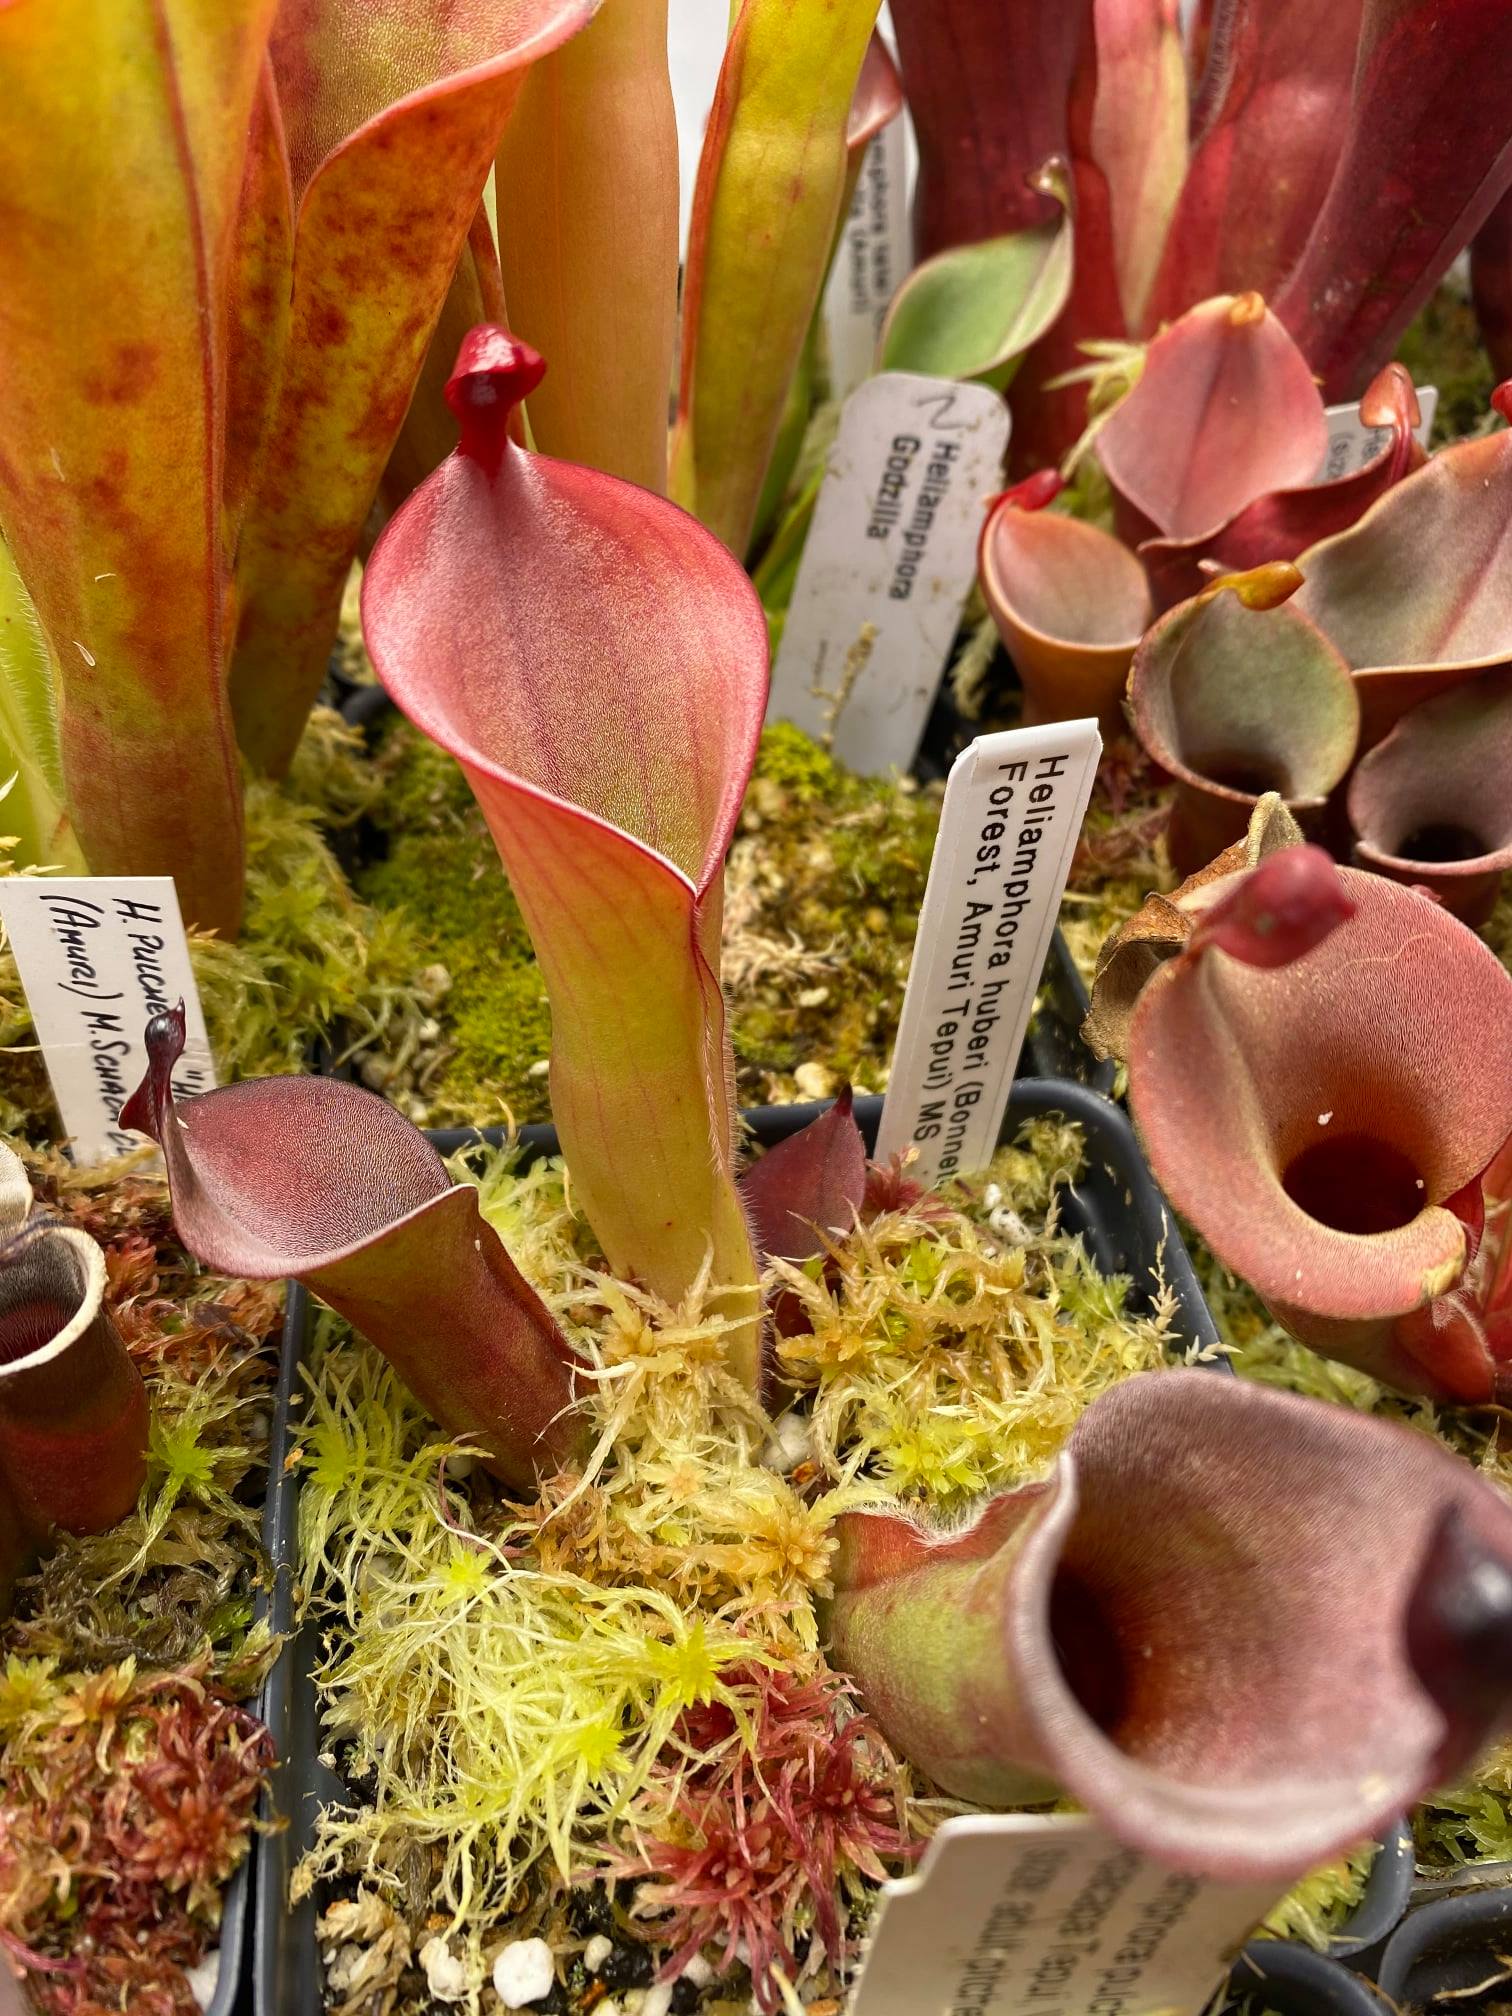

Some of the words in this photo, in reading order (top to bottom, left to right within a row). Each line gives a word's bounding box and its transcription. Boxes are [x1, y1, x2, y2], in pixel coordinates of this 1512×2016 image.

[867, 433, 921, 540] Godzilla
[889, 440, 960, 600] Heliamphora
[967, 760, 1028, 886] Forest,
[987, 754, 1069, 970] Heliamphora
[112, 898, 163, 924] H.
[947, 901, 993, 991] Amuri
[922, 999, 971, 1090] Tepui)
[963, 979, 1010, 1071] huberi
[913, 1100, 946, 1142] MS
